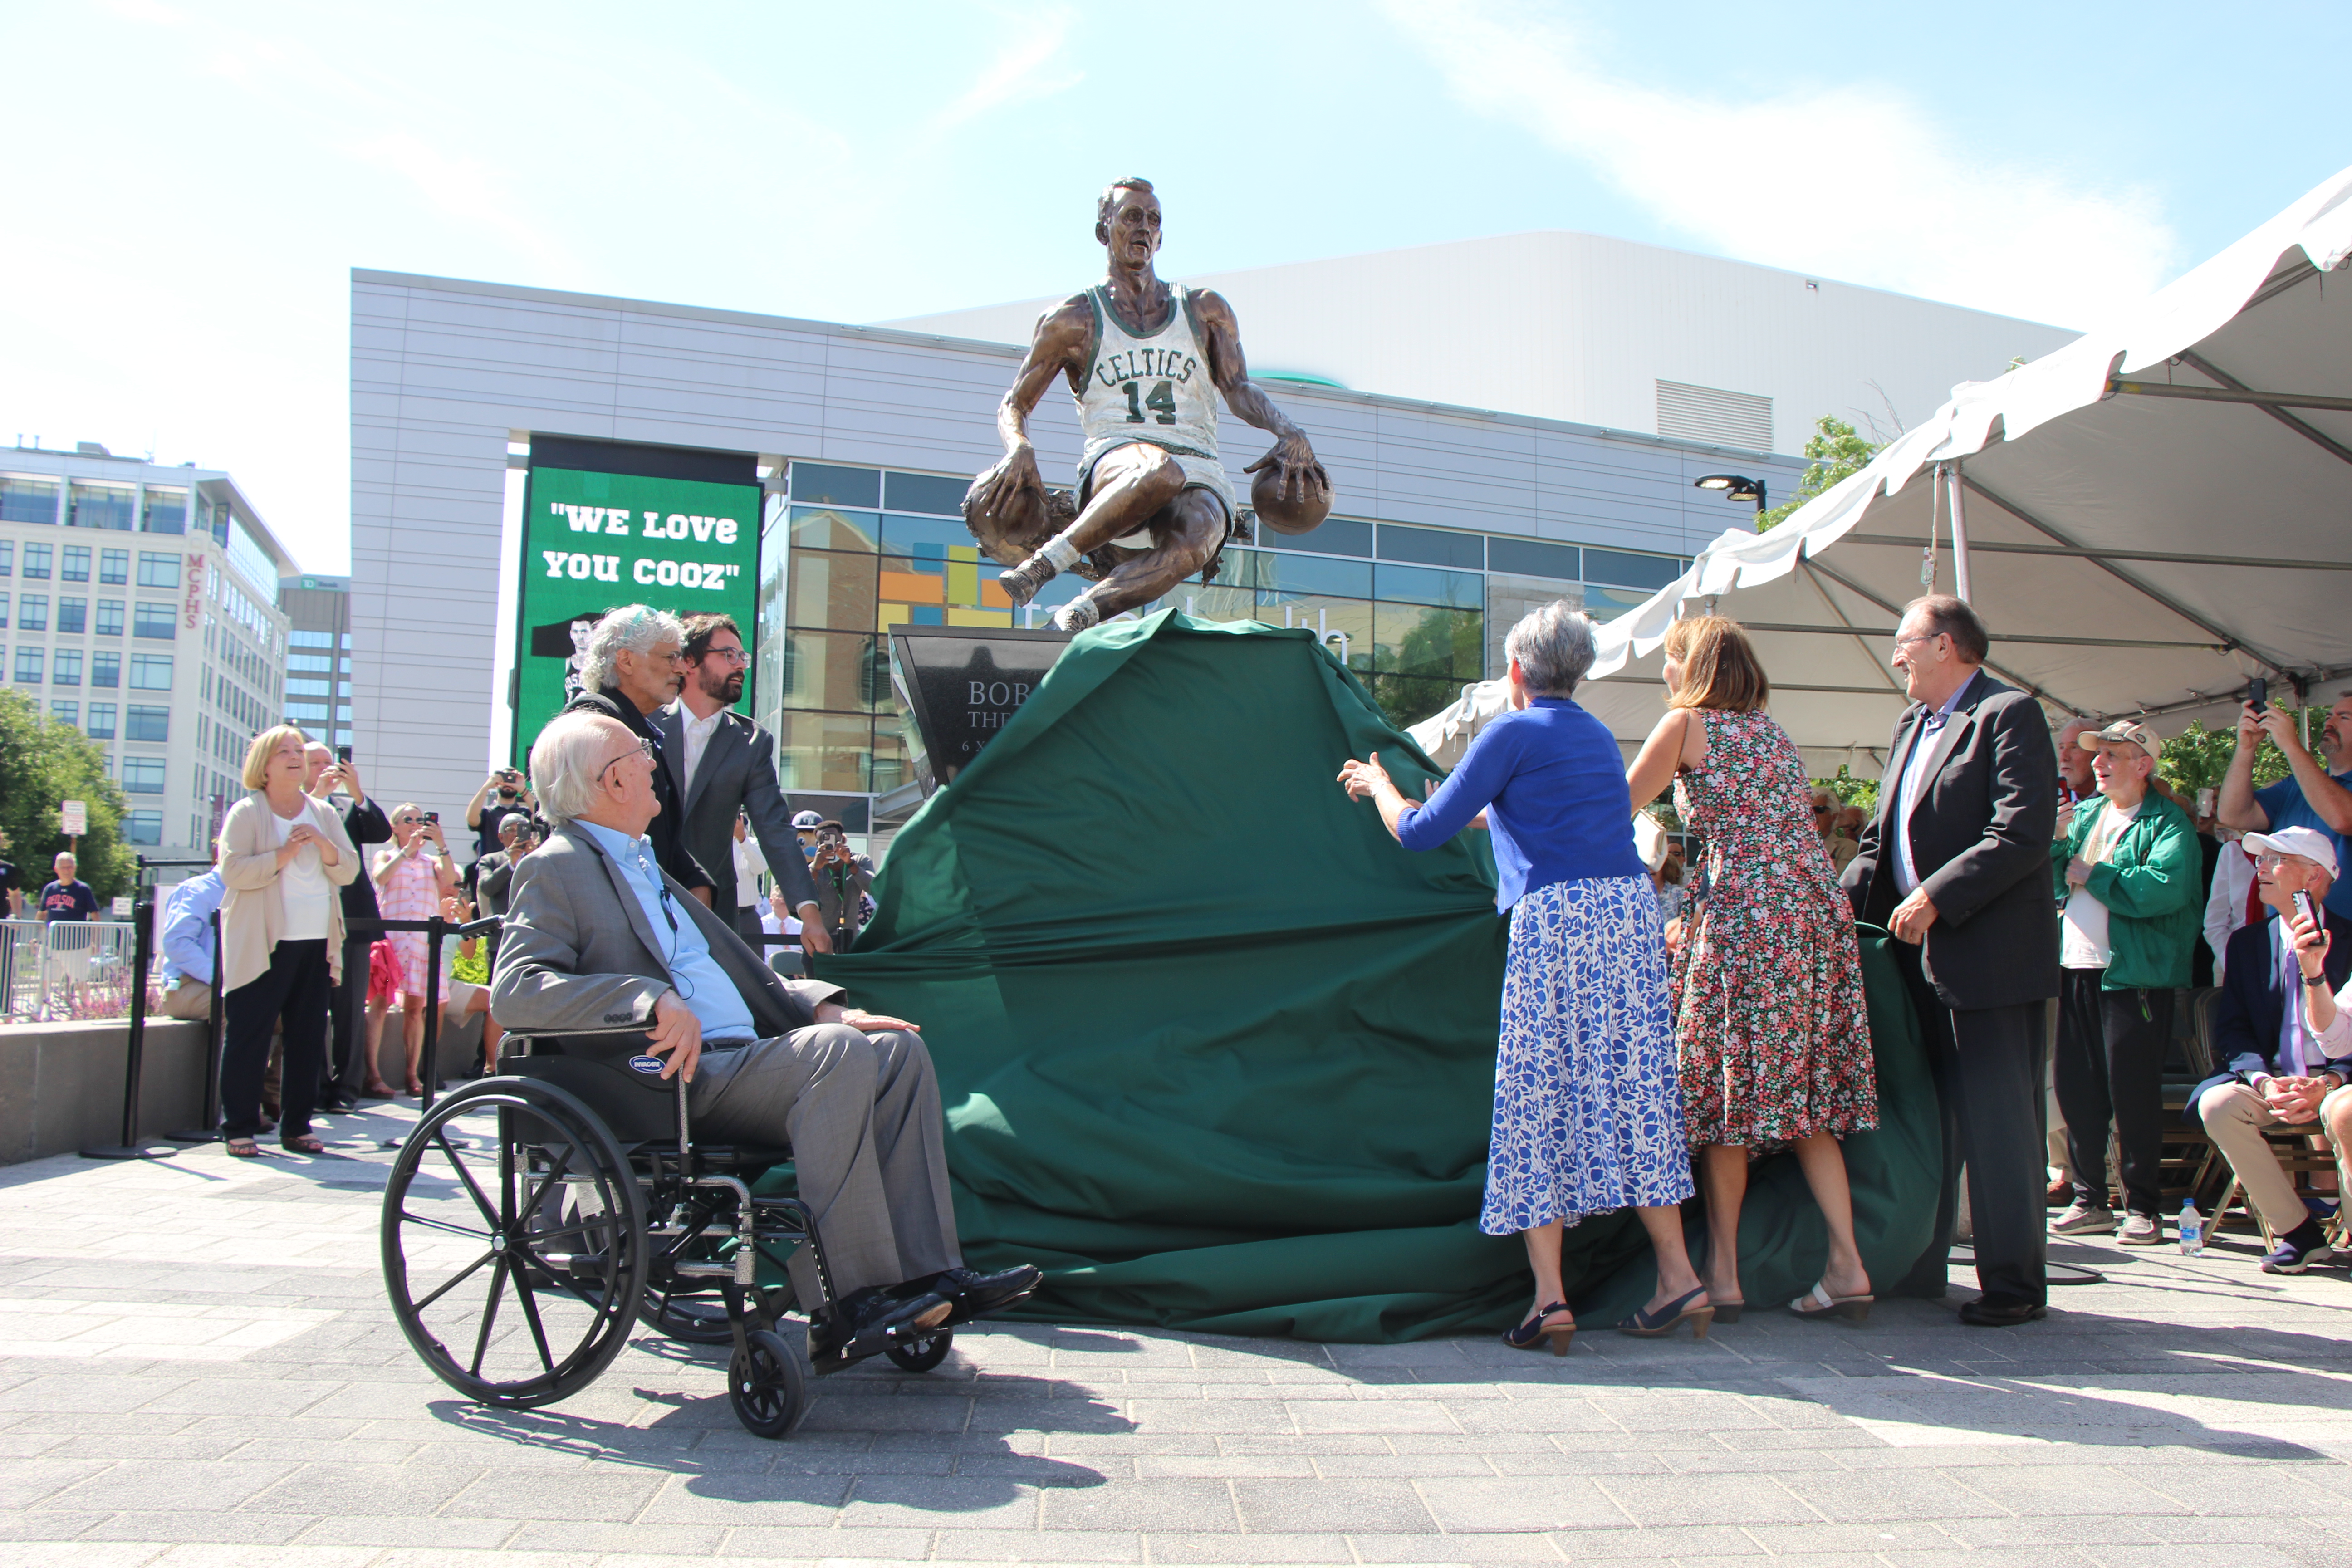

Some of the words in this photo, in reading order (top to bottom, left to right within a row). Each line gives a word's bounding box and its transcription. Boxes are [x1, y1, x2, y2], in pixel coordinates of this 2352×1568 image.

[1096, 348, 1197, 387] CELTICS
[1122, 380, 1176, 425] 14
[302, 579, 314, 588] TD
[542, 551, 620, 582] YOU
[633, 559, 740, 590] COOZ"
[185, 553, 205, 629] MCPHS
[968, 681, 1029, 706] BOB
[962, 740, 970, 751] 6
[46, 894, 60, 907] RED
[62, 894, 76, 908] SOX
